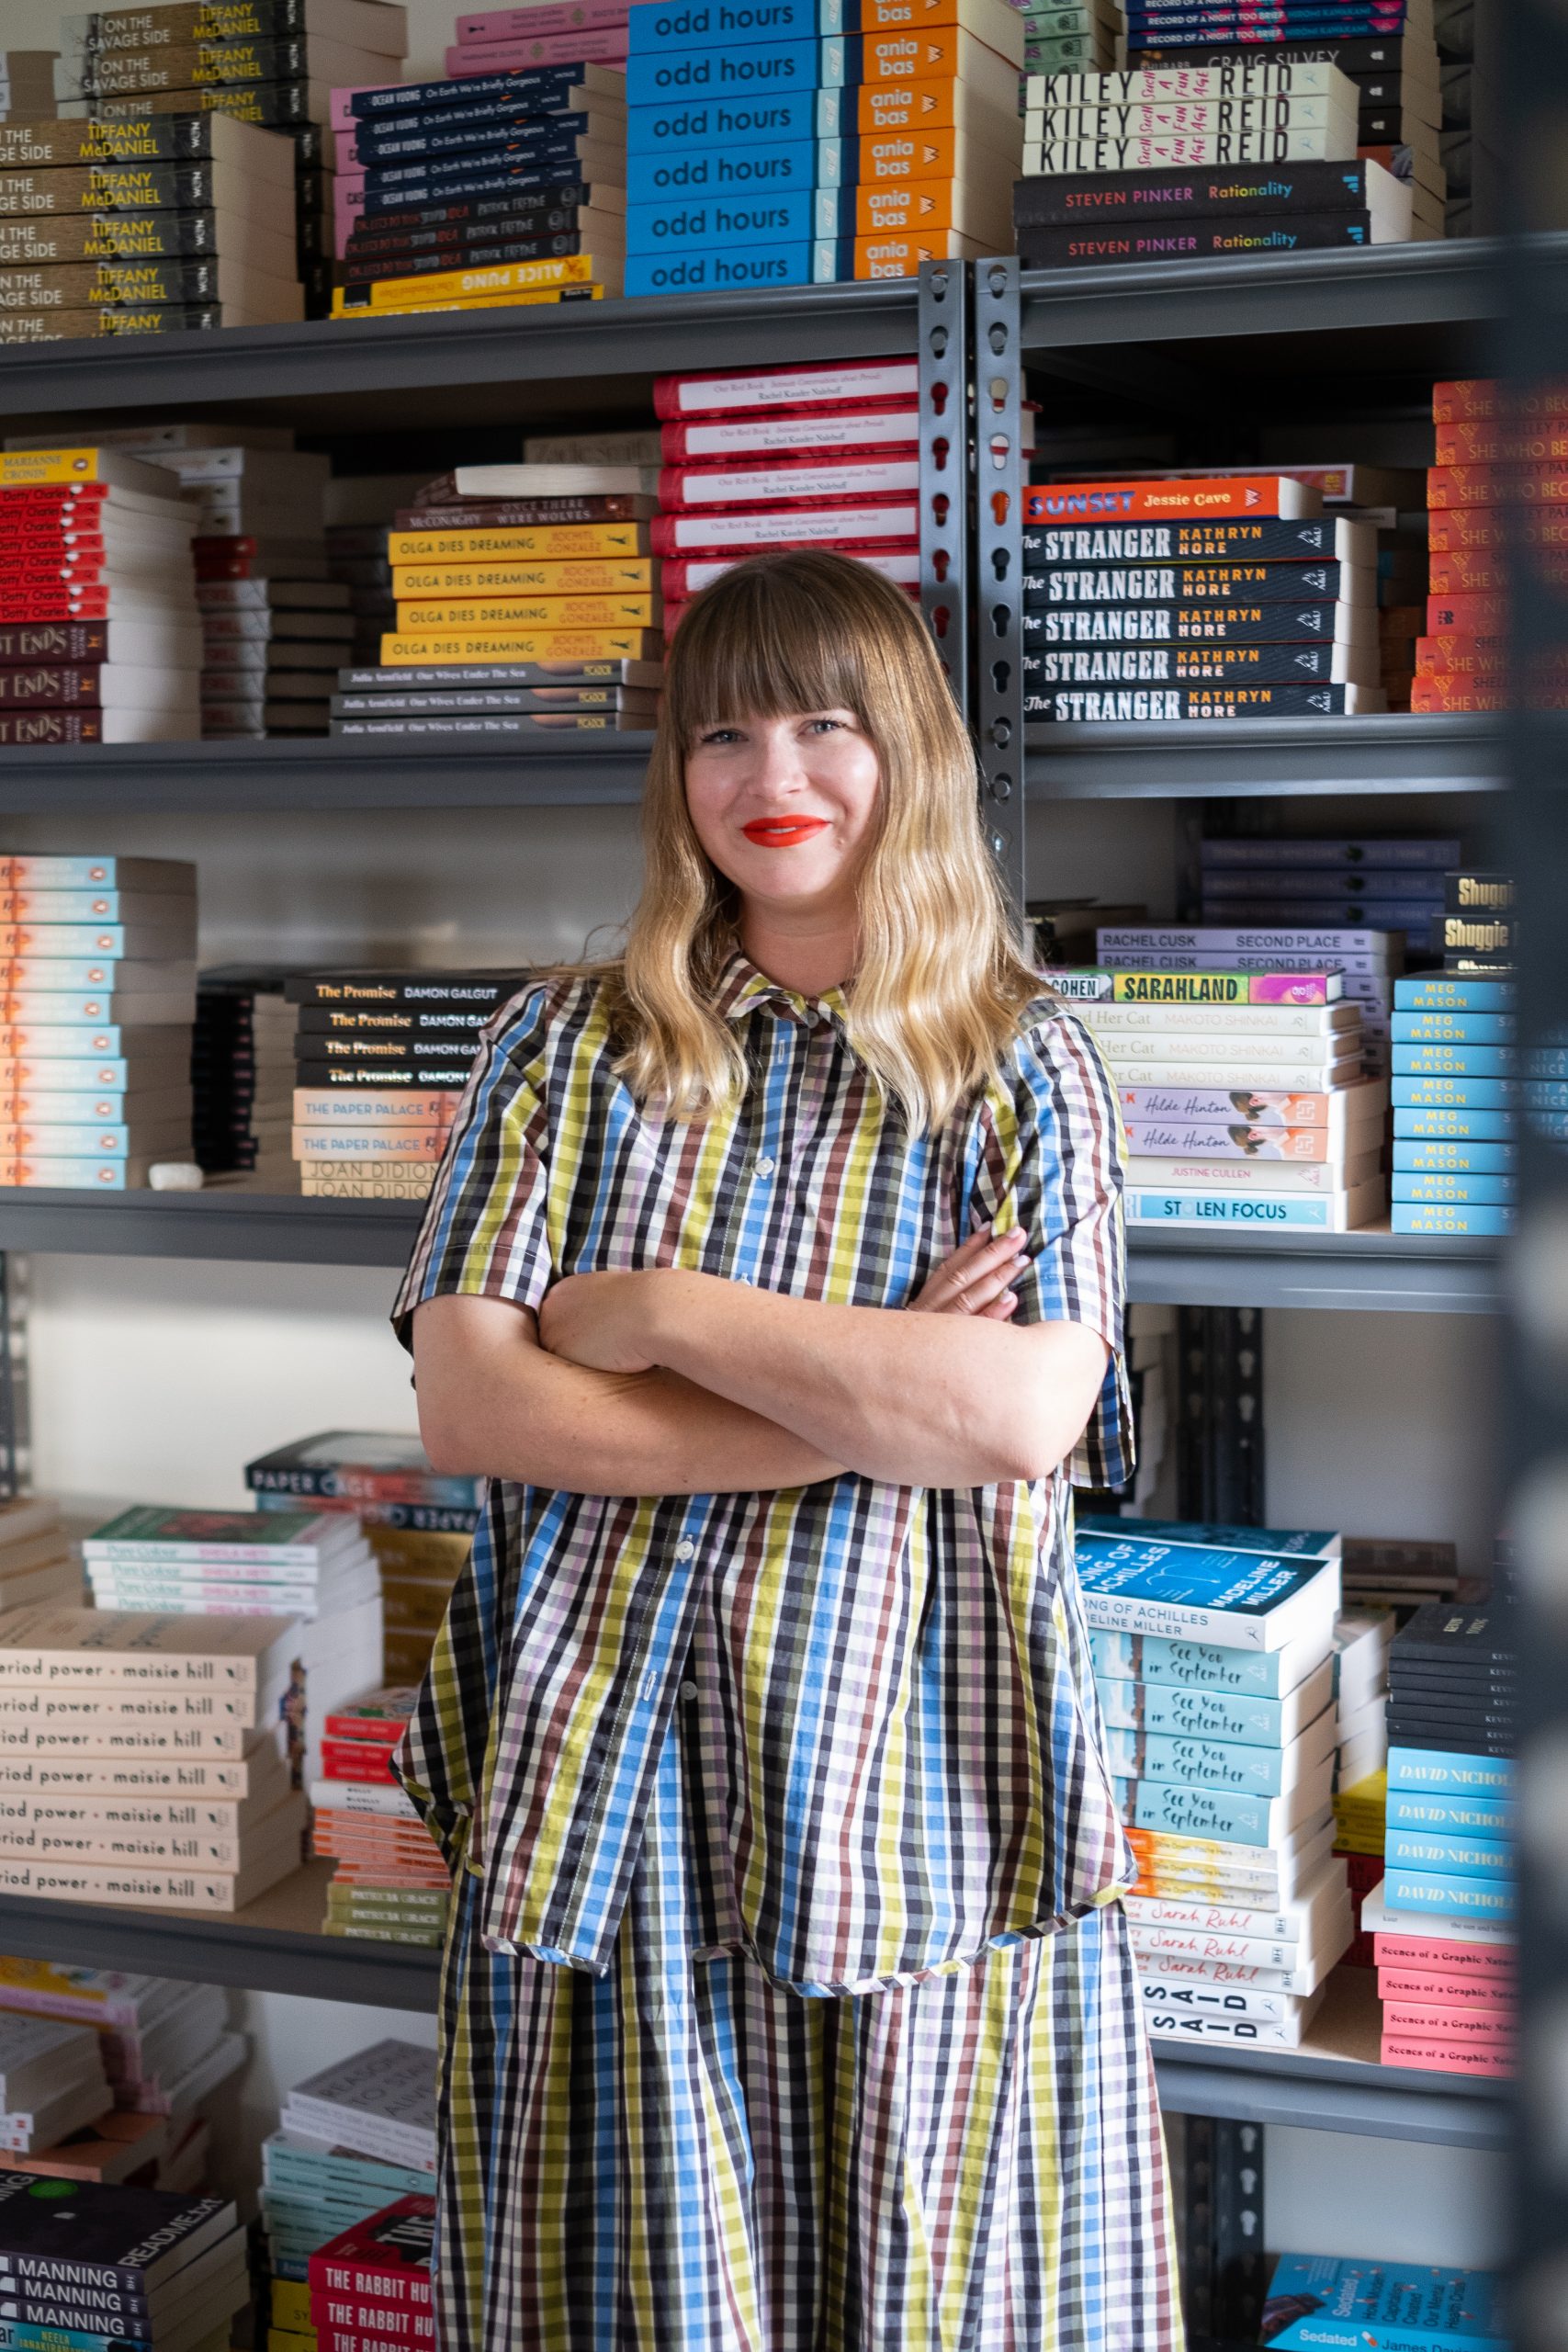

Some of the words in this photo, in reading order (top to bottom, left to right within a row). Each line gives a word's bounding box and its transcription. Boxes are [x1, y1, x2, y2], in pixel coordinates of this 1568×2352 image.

[199, 4, 253, 22] TIFFANY
[1147, 15, 1184, 26] RECORD
[1186, 14, 1198, 24] OF
[1199, 14, 1206, 24] A
[1208, 13, 1235, 22] NIGHT
[1238, 12, 1258, 21] TOO
[1259, 11, 1284, 20] BRIEF
[105, 19, 124, 33] ON
[129, 16, 152, 30] THE
[193, 19, 261, 40] McDANIEL
[88, 33, 139, 52] SAVAGE
[142, 29, 170, 46] SIDE
[875, 40, 918, 58] ania
[655, 60, 710, 87] odd
[720, 57, 795, 82] hours
[879, 60, 914, 76] bas
[426, 88, 438, 98] On
[439, 85, 457, 96] Earth
[506, 75, 540, 89] Gorgeous
[1044, 73, 1134, 105] KILEY
[1158, 80, 1173, 90] A
[1220, 65, 1292, 96] REID
[871, 91, 913, 107] ania
[653, 110, 707, 138] odd
[717, 108, 791, 131] hours
[874, 109, 908, 126] bas
[1043, 106, 1132, 137] KILEY
[1219, 98, 1290, 130] REID
[6, 130, 32, 144] THE
[88, 123, 152, 141] TIFFANY
[18, 145, 52, 161] SIDE
[79, 141, 160, 159] McDANIEL
[872, 141, 914, 158] ania
[653, 160, 708, 187] odd
[718, 158, 792, 182] hours
[875, 160, 910, 176] bas
[1066, 192, 1126, 208] STEVEN
[1133, 187, 1194, 204] PINKER
[1209, 182, 1292, 199] Rationality
[1068, 241, 1130, 256] STEVEN
[1136, 237, 1198, 253] PINKER
[1213, 232, 1297, 249] Rationality
[462, 270, 510, 290] PUNG
[516, 263, 563, 283] ALICE
[1028, 491, 1135, 516] SUNSET
[1143, 493, 1190, 509] Jessie
[1194, 492, 1231, 506] Cave
[400, 542, 433, 555] OLGA
[438, 540, 464, 553] DIES
[469, 538, 535, 551] DREAMING
[1045, 528, 1171, 560] STRANGER
[1179, 526, 1262, 541] KATHRYN
[1179, 541, 1226, 555] HORE
[405, 576, 439, 588] OLGA
[445, 574, 471, 587] DIES
[477, 572, 545, 585] DREAMING
[1049, 570, 1175, 601] STRANGER
[1183, 569, 1266, 582] KATHRYN
[1183, 582, 1231, 595] HORE
[492, 670, 509, 679] The
[1025, 696, 1051, 712] The
[1055, 690, 1180, 721] STRANGER
[1189, 691, 1272, 705] KATHRYN
[1189, 705, 1236, 718] HORE
[1104, 935, 1157, 947] RACHEL
[1159, 935, 1196, 947] CUSK
[1236, 935, 1293, 947] SECOND
[1297, 935, 1341, 948] PLACE
[1445, 919, 1509, 951] Shuggie
[316, 985, 341, 998] The
[344, 986, 397, 999] Promise
[404, 987, 448, 999] DAMON
[451, 988, 498, 1000] GALGUT
[1124, 978, 1237, 1001] SARAHLAND
[1096, 1011, 1124, 1025] Her
[1128, 1011, 1151, 1025] Cat
[1165, 1014, 1217, 1026] MAKOTO
[1221, 1014, 1278, 1026] SHINKAI
[1422, 1047, 1452, 1058] MEG
[1411, 1061, 1466, 1072] MASON
[304, 1102, 331, 1114] THE
[334, 1103, 372, 1114] PAPER
[376, 1104, 423, 1114] PALACE
[1143, 1094, 1179, 1114] Hilde
[1184, 1095, 1231, 1114] Hinton
[1426, 1145, 1457, 1155] MEG
[312, 1163, 362, 1177] JOAN
[1413, 1159, 1470, 1169] MASON
[1171, 1168, 1210, 1178] JUSTINE
[1212, 1169, 1250, 1179] CULLEN
[1232, 1203, 1286, 1219] FOCUS
[254, 1470, 314, 1490] PAPER
[1094, 1546, 1171, 1593] ACHILLES
[1207, 1559, 1280, 1608] MADELINE
[1242, 1570, 1298, 1606] MILLER
[1114, 1602, 1134, 1614] OF
[1137, 1606, 1208, 1626] ACHILLES
[1134, 1621, 1182, 1635] MILLER
[1169, 1643, 1190, 1660] See
[1199, 1646, 1223, 1664] You
[51, 1665, 103, 1679] power
[123, 1665, 179, 1679] maisie
[186, 1663, 214, 1679] hill
[1149, 1664, 1162, 1673] in
[1170, 1661, 1243, 1685] September
[40, 1769, 93, 1784] power
[114, 1770, 168, 1785] maisie
[177, 1769, 205, 1786] hill
[1399, 1765, 1448, 1781] DAVID
[1152, 1902, 1201, 1922] Sarah
[1205, 1909, 1251, 1930] Ruhl
[1382, 1947, 1416, 1957] Scenes
[1442, 1953, 1482, 1964] Graphic
[1144, 1985, 1247, 2010] SAID
[1153, 2017, 1258, 2038] SAID
[118, 2199, 223, 2268] README.txt
[18, 2256, 117, 2290] MANNING
[326, 2267, 350, 2290] THE
[355, 2273, 406, 2298] RABBIT
[25, 2279, 122, 2312] MANNING
[1332, 2278, 1359, 2318] Sedated
[1299, 2328, 1358, 2346] Sedated
